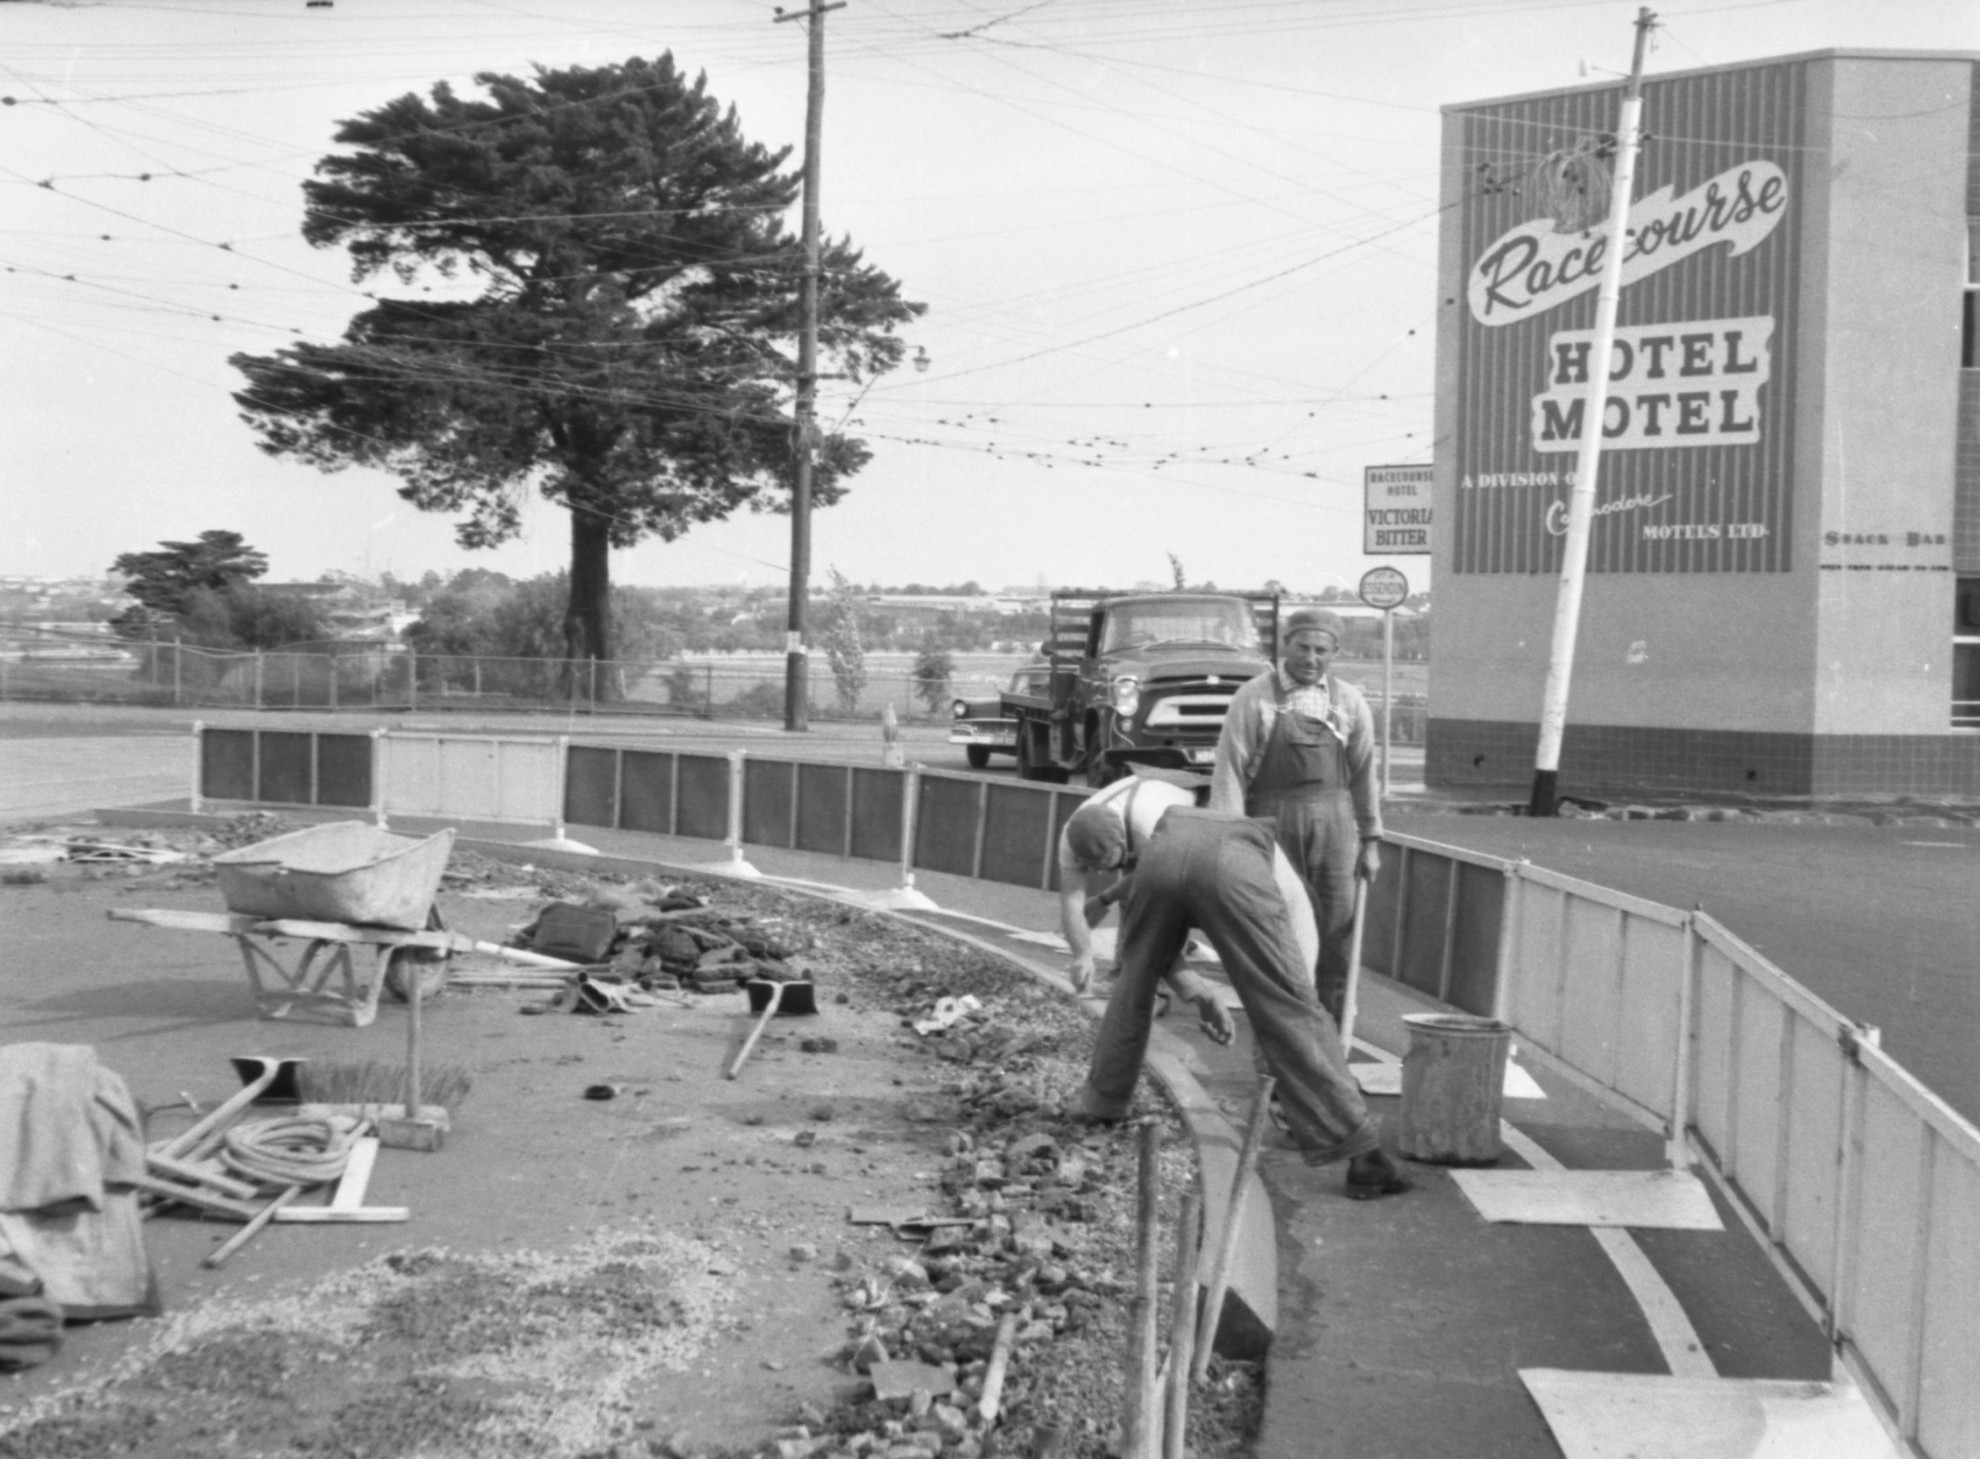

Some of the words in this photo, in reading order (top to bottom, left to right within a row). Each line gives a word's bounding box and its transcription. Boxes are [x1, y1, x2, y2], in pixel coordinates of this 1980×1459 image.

[1480, 169, 1786, 316] Raceourse
[1555, 330, 1757, 384] HOTEL
[1541, 390, 1754, 441] MOTEL
[1387, 485, 1418, 496] HOTEL
[1461, 474, 1473, 488] A
[1478, 472, 1558, 488] DIVISION
[1546, 494, 1674, 536] Coodore
[1376, 528, 1428, 546] BITTER
[1642, 524, 1721, 540] MOTELS
